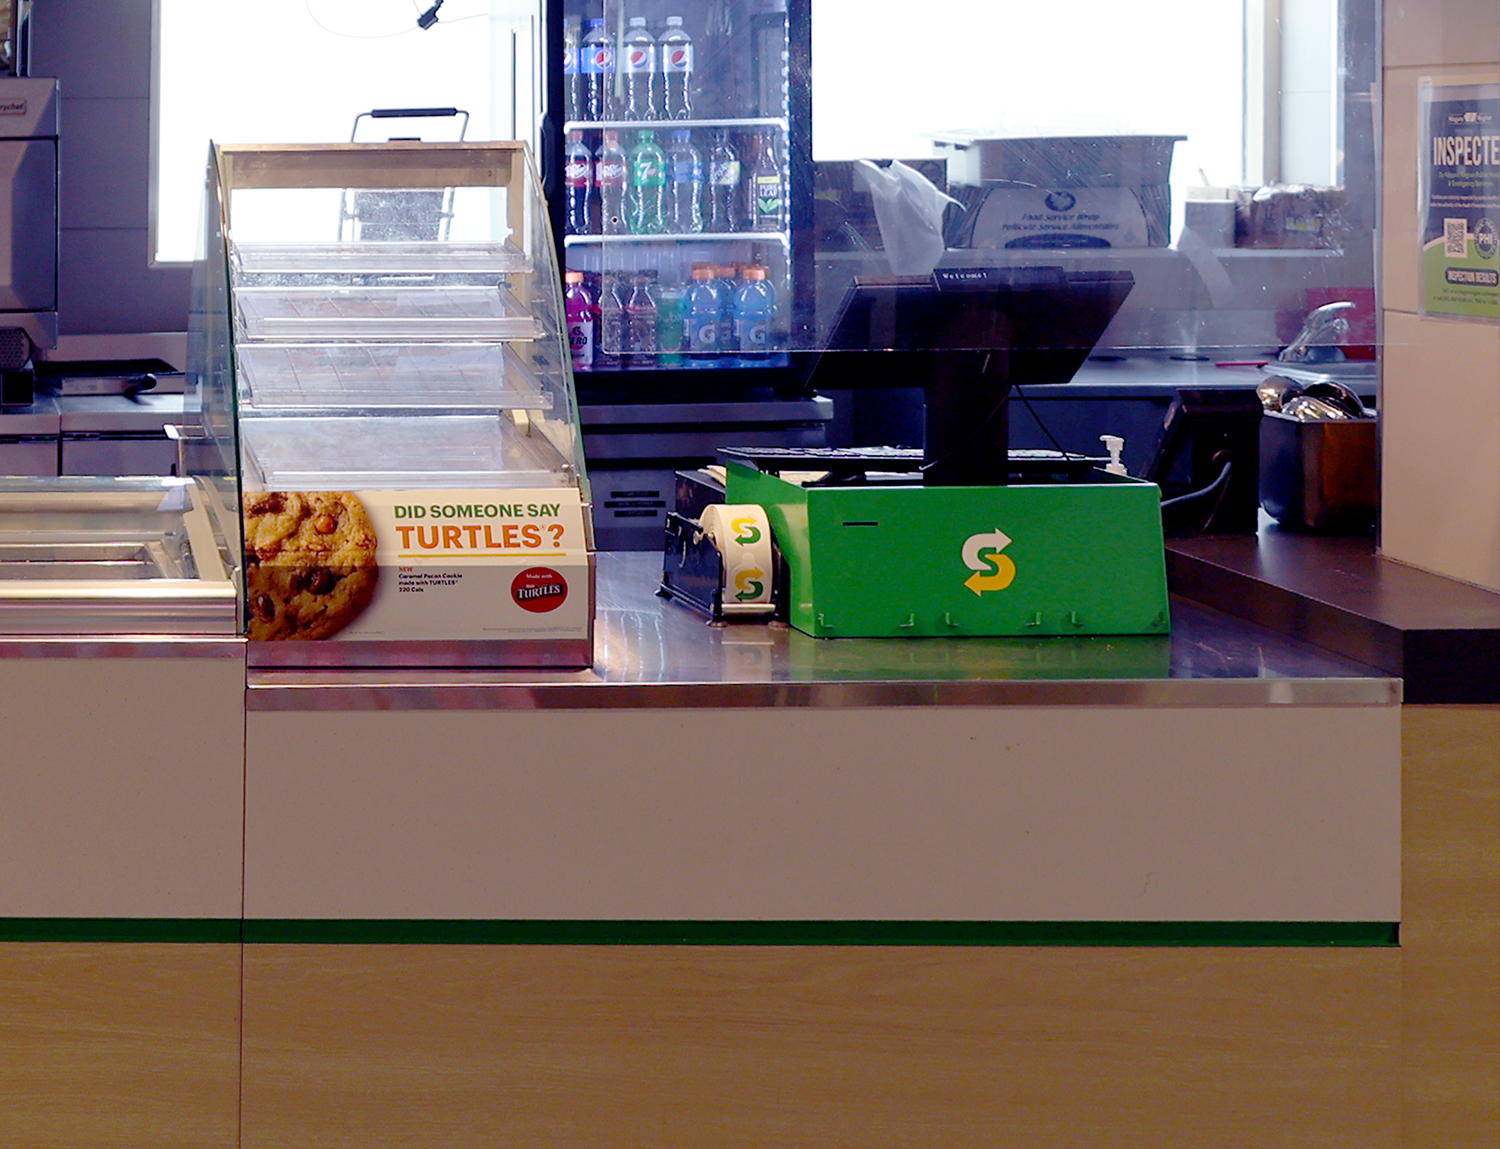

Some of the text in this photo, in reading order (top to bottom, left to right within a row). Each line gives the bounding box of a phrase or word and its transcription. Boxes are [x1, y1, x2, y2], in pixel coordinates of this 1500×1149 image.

[394, 503, 560, 518] DID SOMEONE SAY
[517, 583, 561, 599] TURTLES
